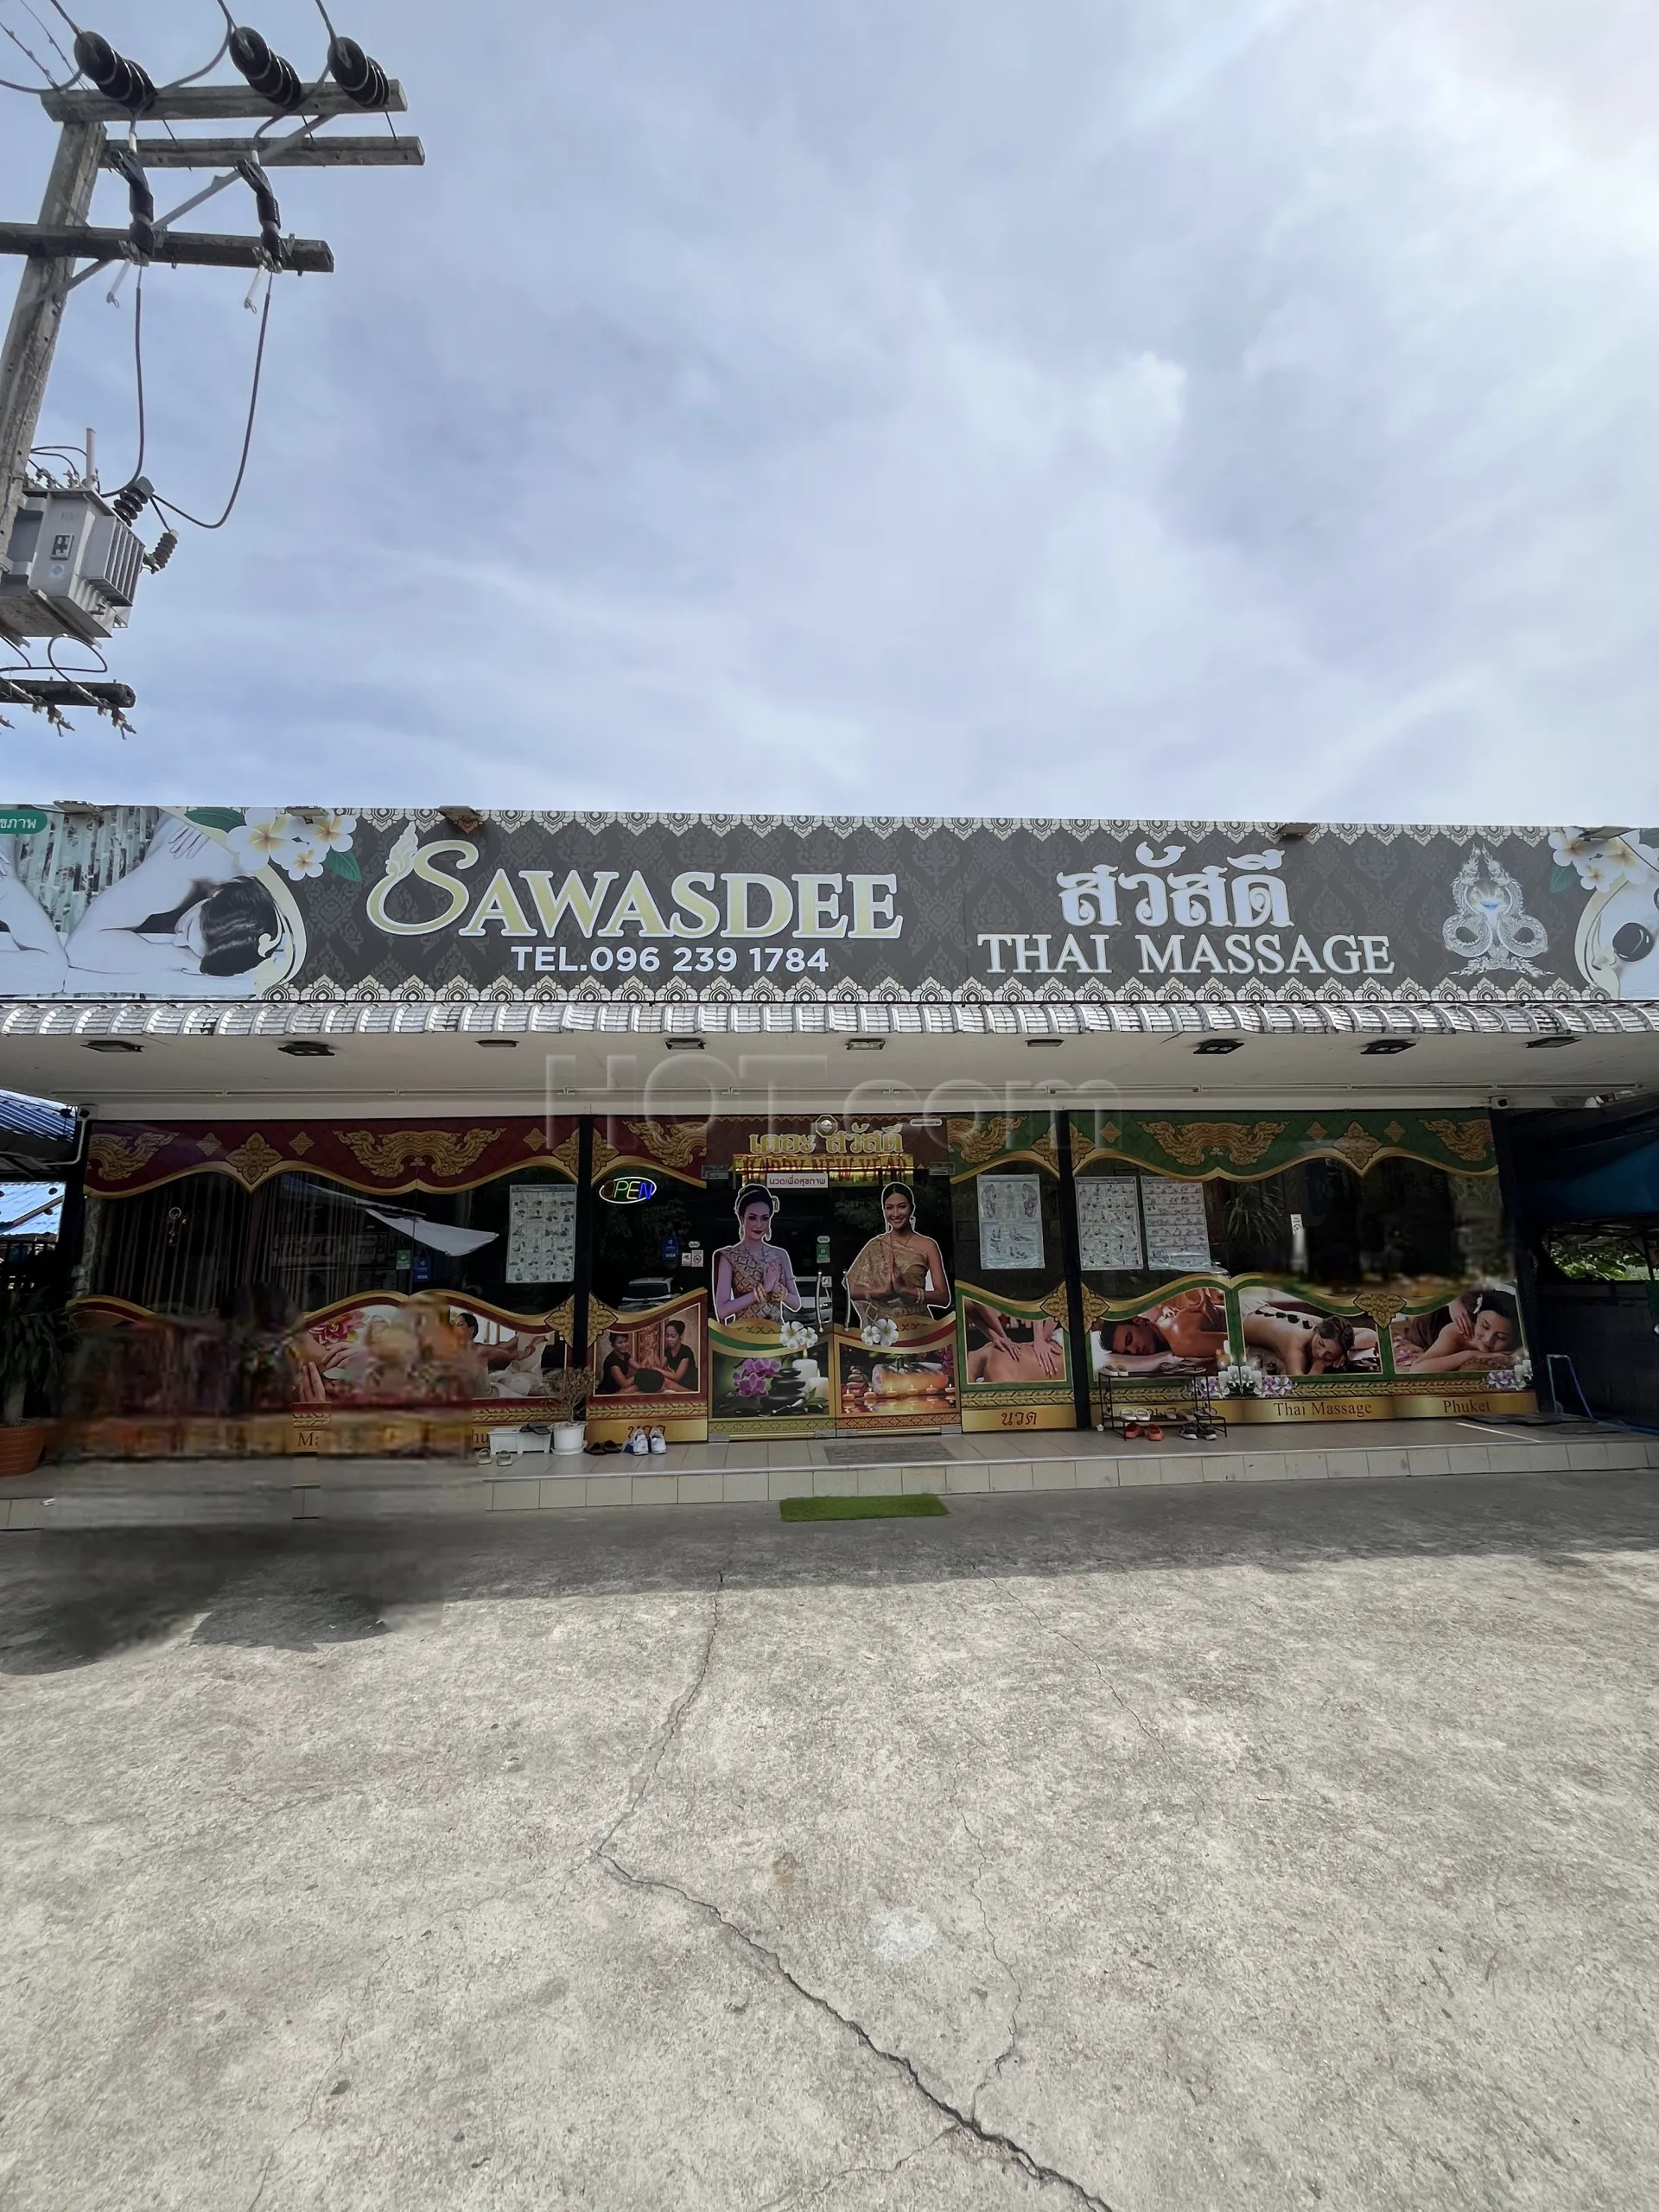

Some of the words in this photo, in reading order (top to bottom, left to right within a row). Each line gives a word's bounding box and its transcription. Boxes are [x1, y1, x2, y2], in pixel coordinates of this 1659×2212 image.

[366, 838, 904, 940] SAWASDEE
[1056, 841, 1295, 929] สวัสดี
[511, 945, 660, 973] TEL.096
[672, 946, 737, 973] 239
[748, 947, 830, 974] 1784
[977, 932, 1113, 975] THAI
[1135, 932, 1396, 976] MASSAGE
[824, 1122, 905, 1154] สวัสดี
[604, 1179, 655, 1200] OPEN
[768, 1174, 826, 1187] นวดเพื่อสุขภาพ
[1001, 1411, 1038, 1426] นวด
[1274, 1402, 1306, 1417] Thai
[1312, 1401, 1372, 1418] Massage
[1443, 1399, 1492, 1414] Phuket
